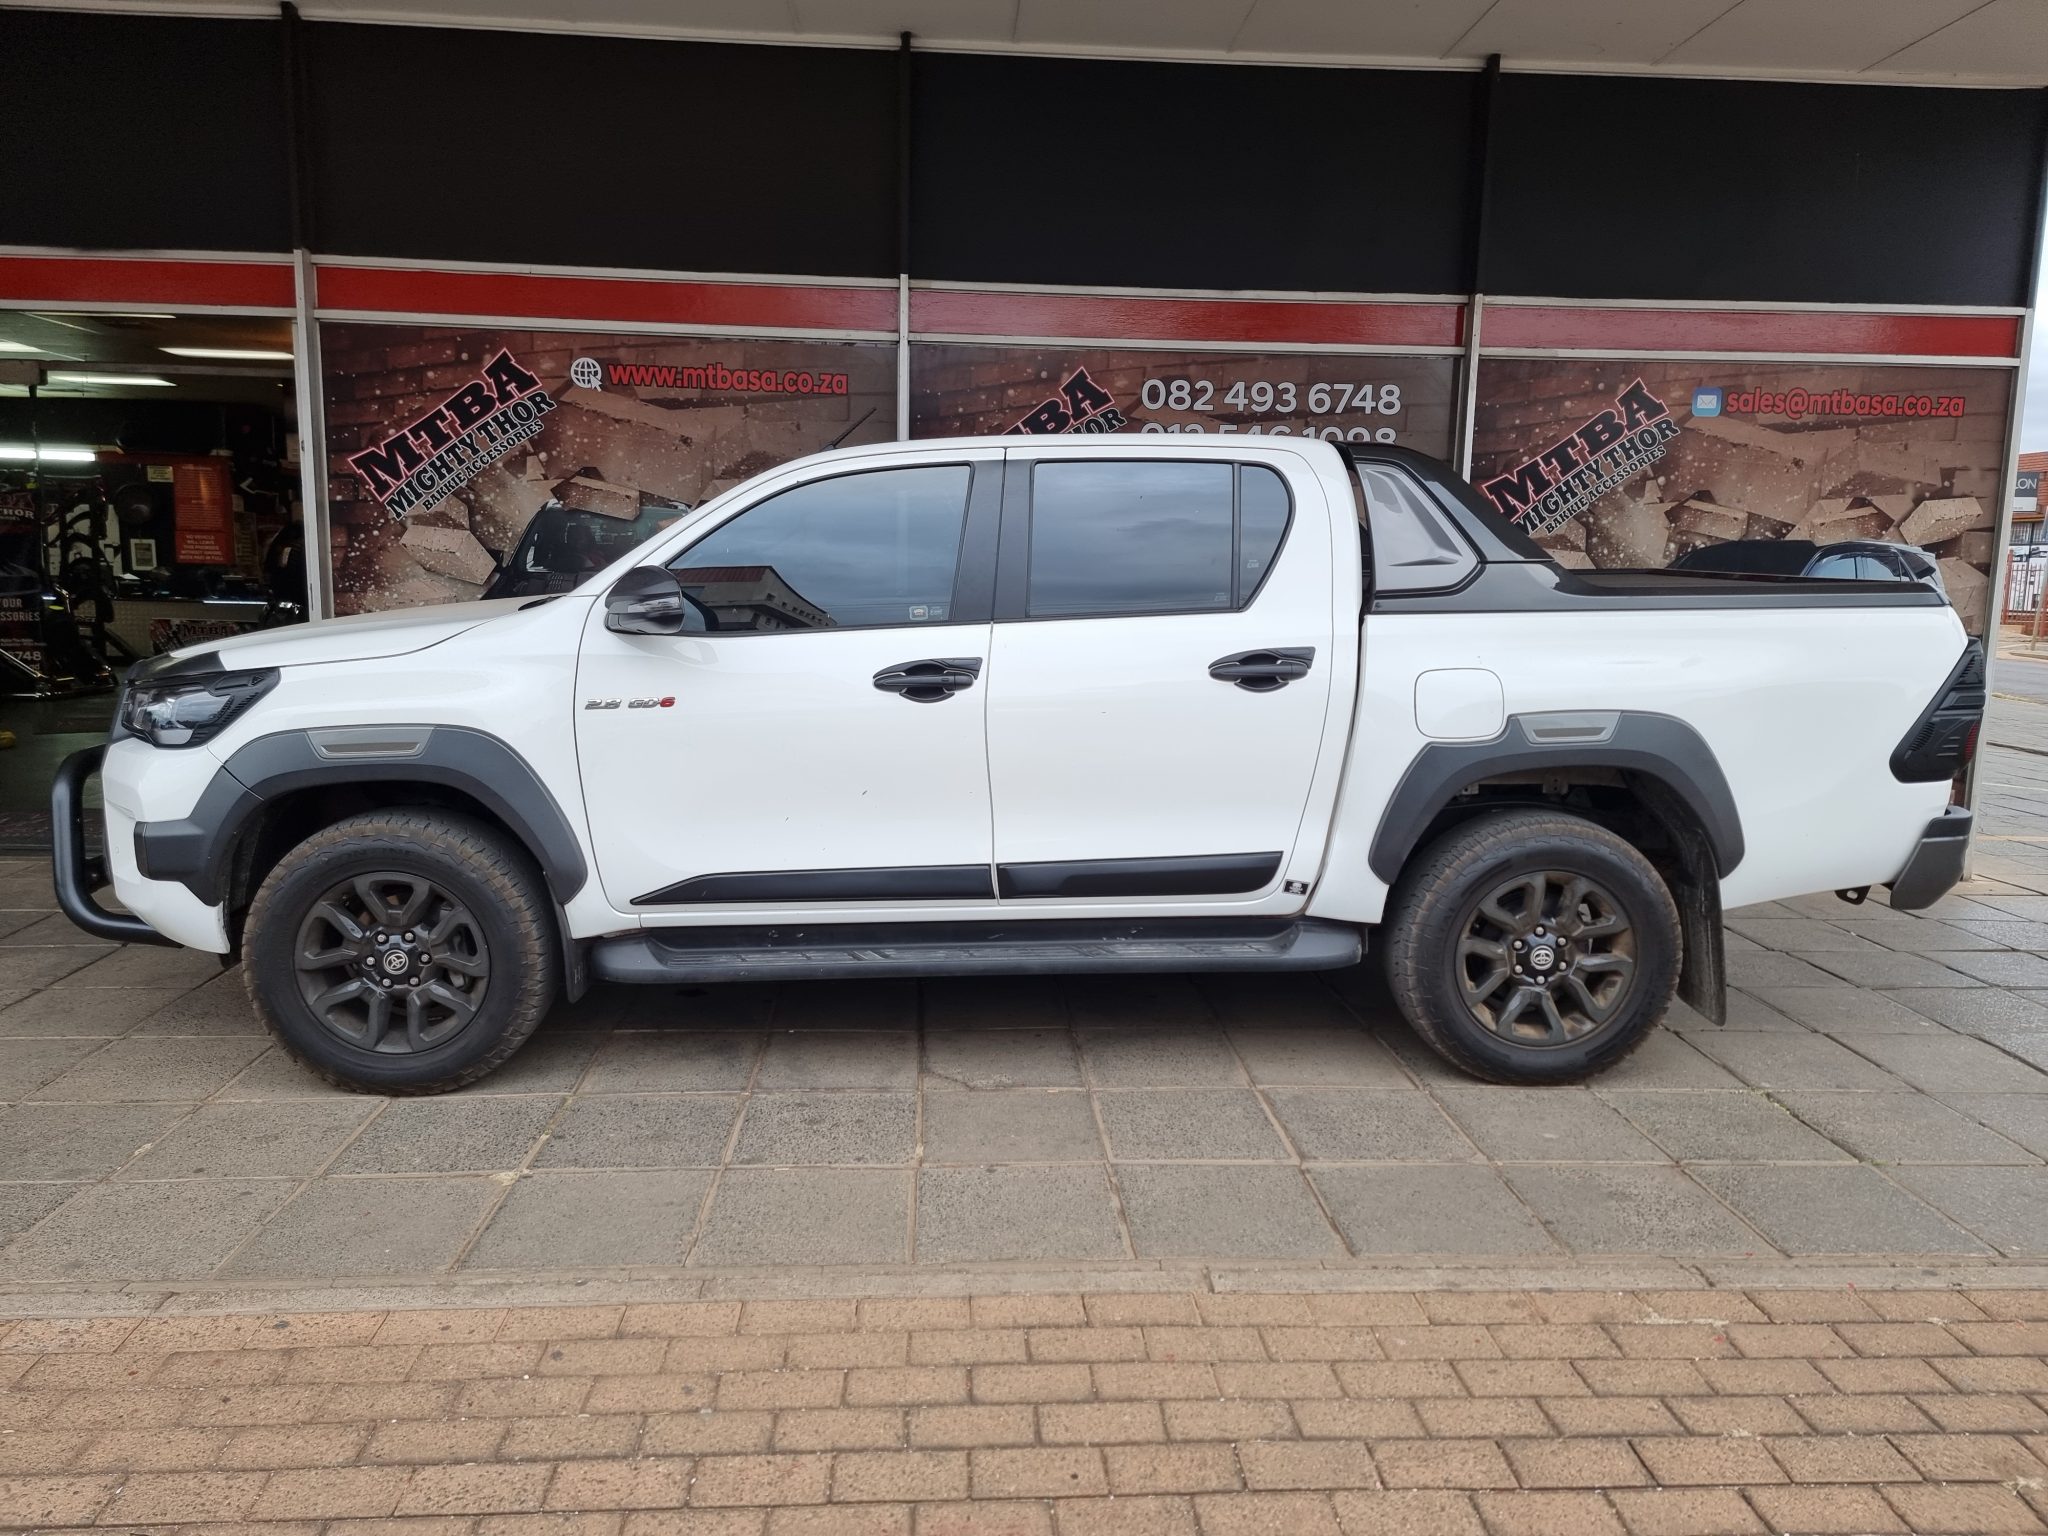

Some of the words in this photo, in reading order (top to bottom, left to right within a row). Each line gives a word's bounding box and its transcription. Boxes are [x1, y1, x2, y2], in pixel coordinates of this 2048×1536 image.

[608, 362, 848, 395] www.mtbasa.co.za
[1141, 379, 1214, 410] 082
[1223, 381, 1297, 413] 493
[1308, 382, 1401, 415] 6748
[1725, 386, 1965, 420] sales@mtbasa.co.za
[348, 347, 542, 502] MTBA
[1481, 377, 1669, 522] MTBA
[1602, 417, 1681, 472] THOR
[384, 432, 480, 521] MIGHTY
[476, 391, 557, 446] THOR
[421, 470, 467, 512] BAKKIE
[465, 420, 544, 479] ACCESSORIES
[1544, 495, 1588, 535] BAKKIE
[1587, 444, 1667, 503] ACCESSORIES
[2013, 478, 2037, 490] ON
[0, 597, 23, 608] OUR
